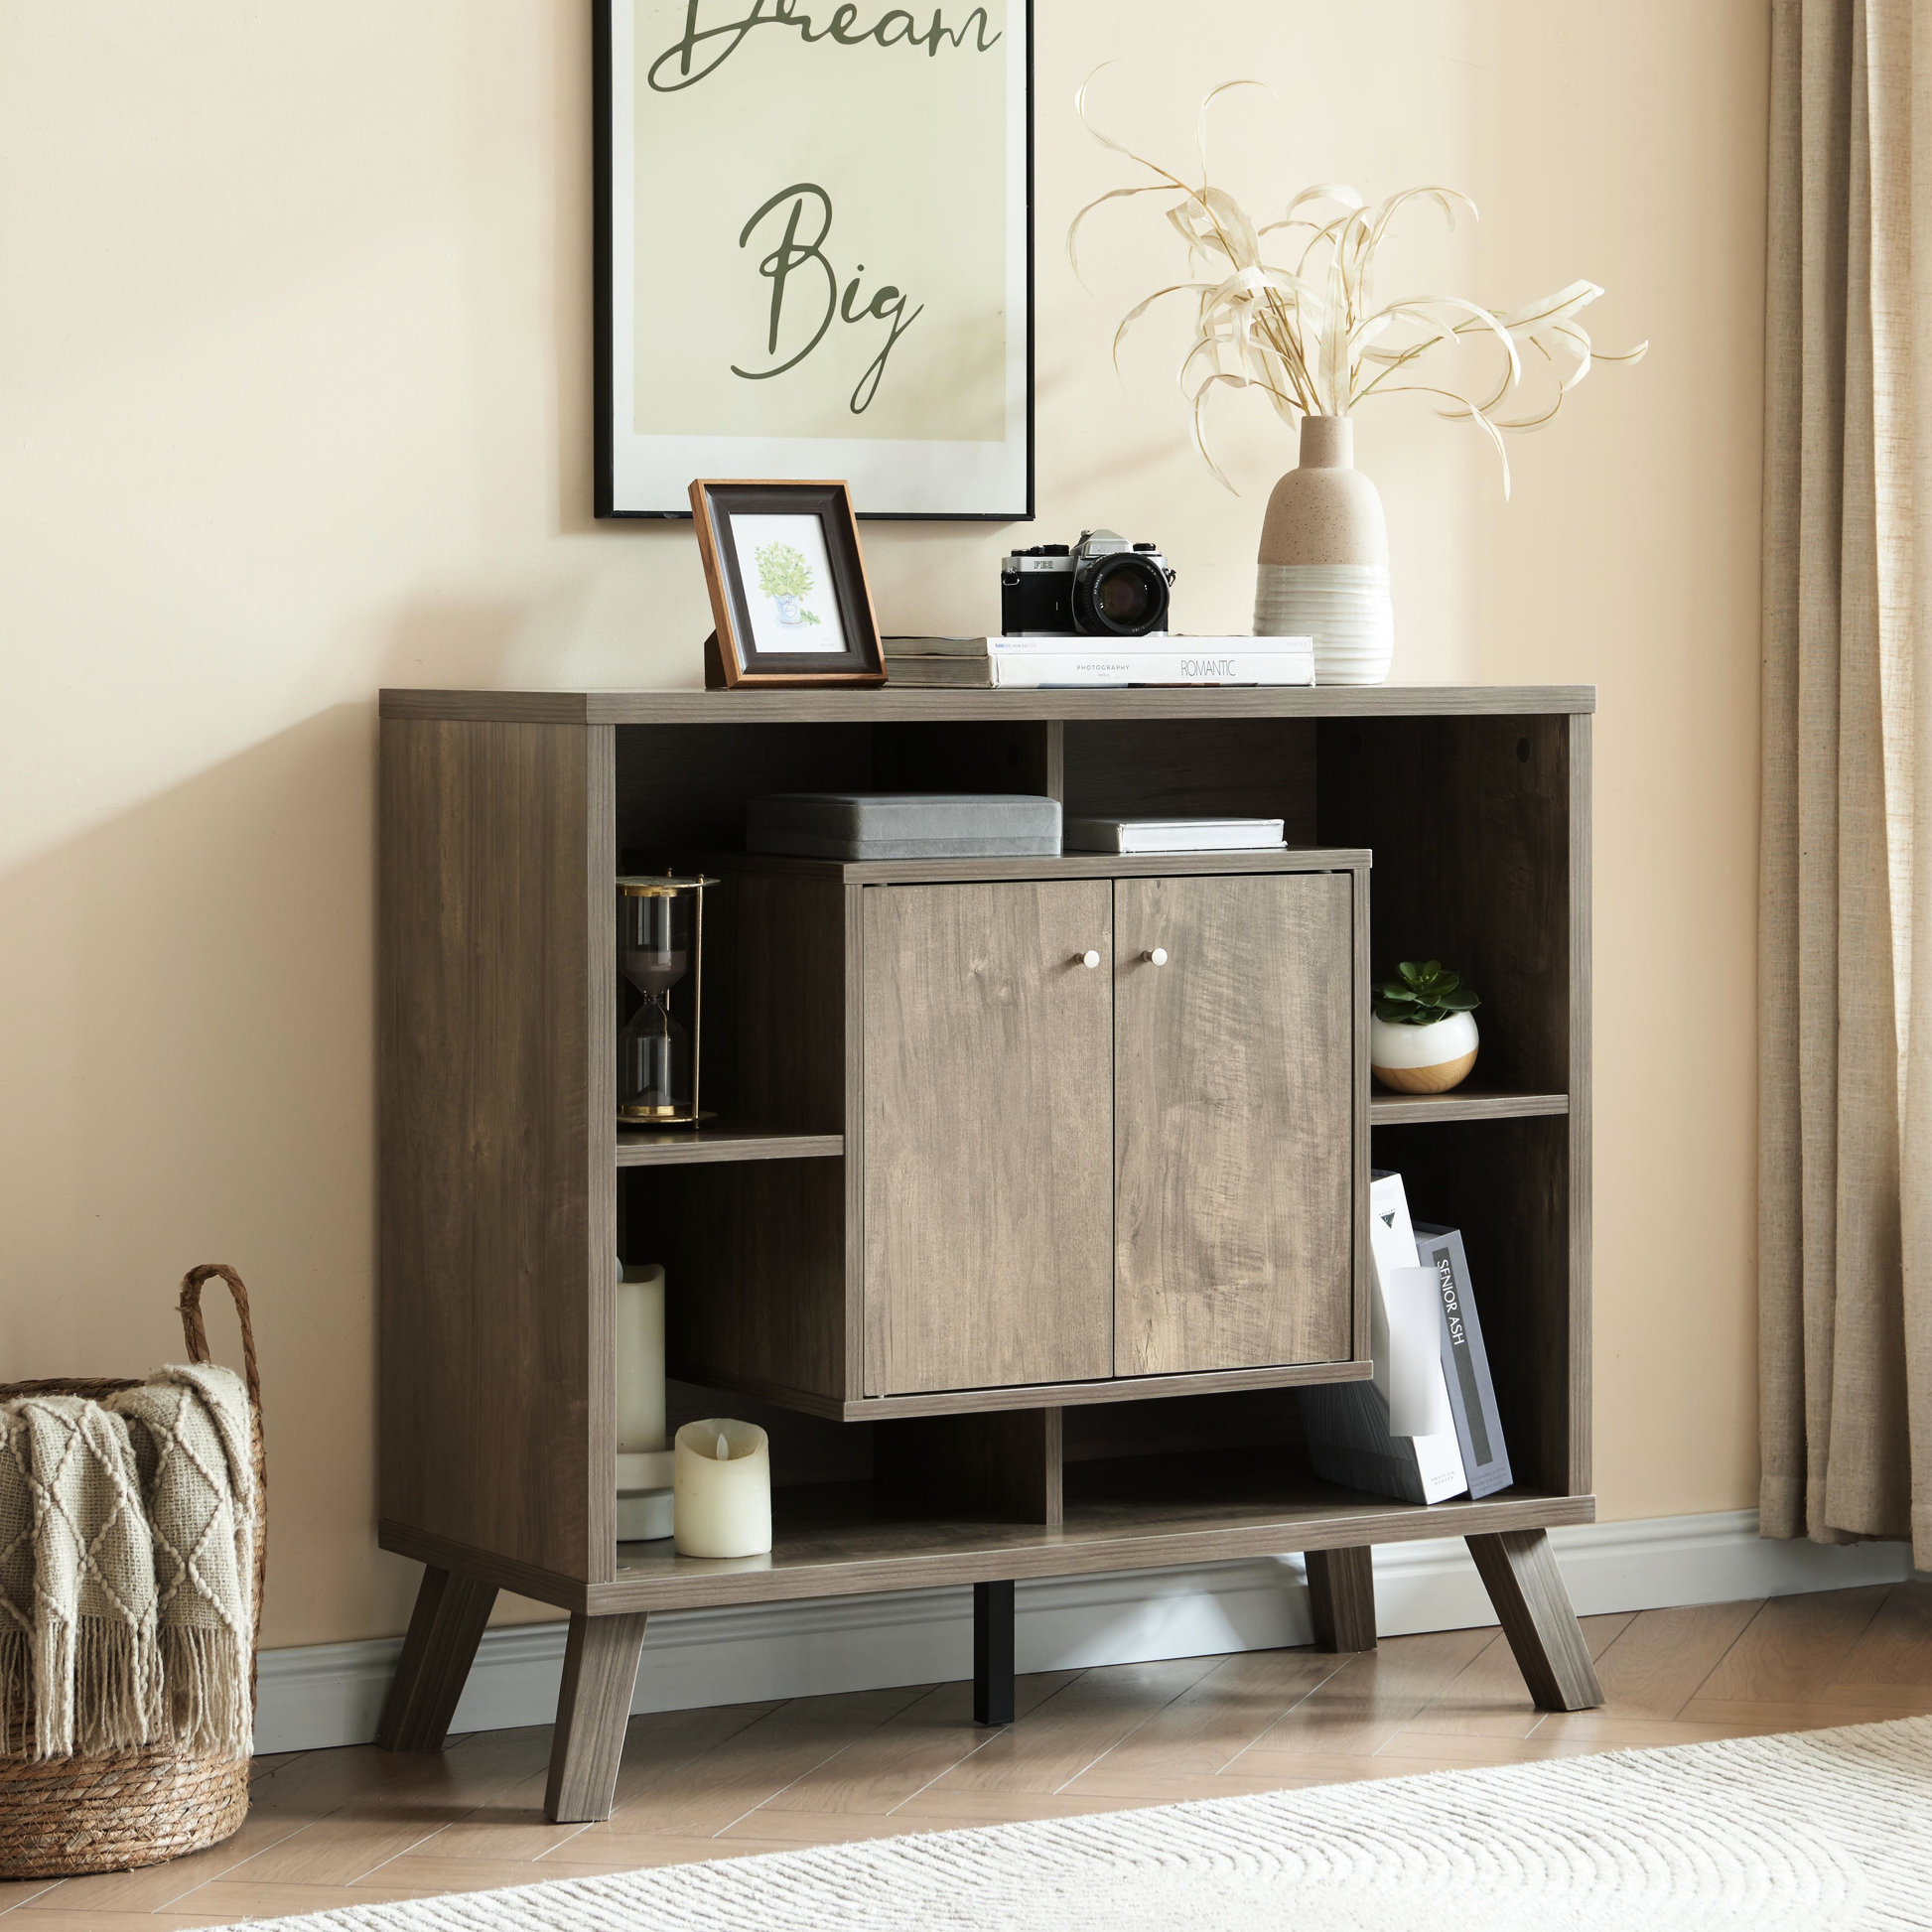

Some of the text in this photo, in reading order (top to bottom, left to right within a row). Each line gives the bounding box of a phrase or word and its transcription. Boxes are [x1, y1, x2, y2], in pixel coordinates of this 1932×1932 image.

[730, 182, 924, 415] Big
[1180, 659, 1236, 677] ROMANTIC
[1437, 1259, 1465, 1345] SENIOR ASH
